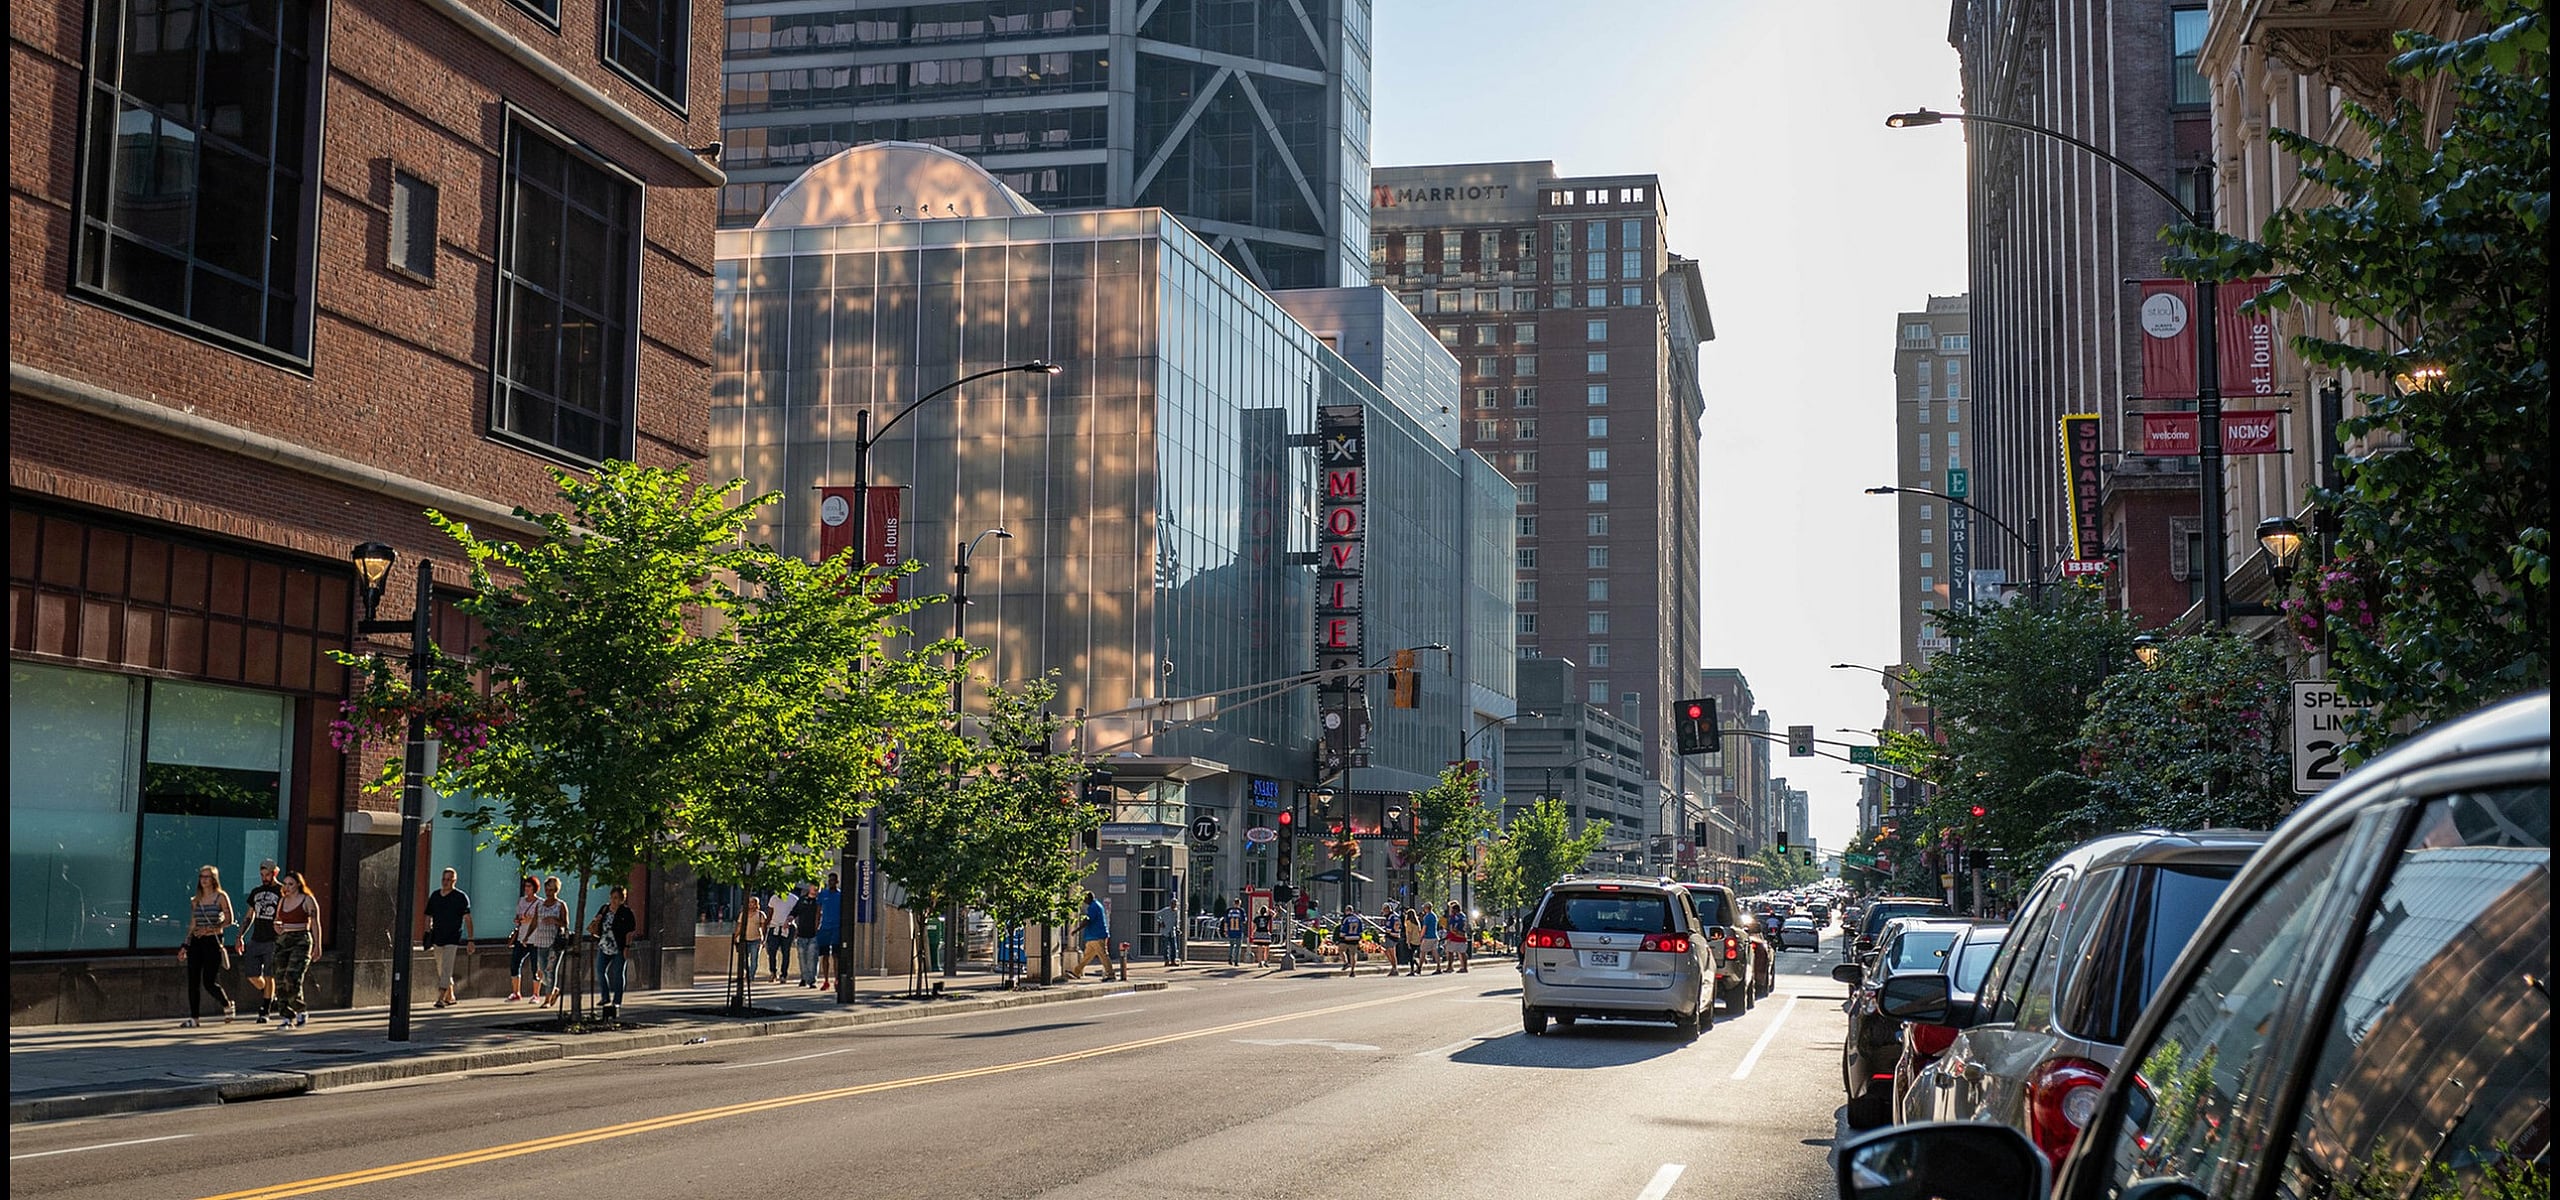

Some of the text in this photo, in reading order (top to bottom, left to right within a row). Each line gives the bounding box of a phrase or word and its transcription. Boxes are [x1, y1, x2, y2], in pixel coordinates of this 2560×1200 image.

[1398, 185, 1508, 203] MARRIOTT
[2248, 323, 2271, 395] st. louis
[2151, 430, 2190, 441] welcome
[2228, 423, 2269, 440] NCMS
[2078, 422, 2099, 557] SUGARFIRE
[884, 518, 898, 548] louis
[1951, 507, 1965, 589] EMBASSY
